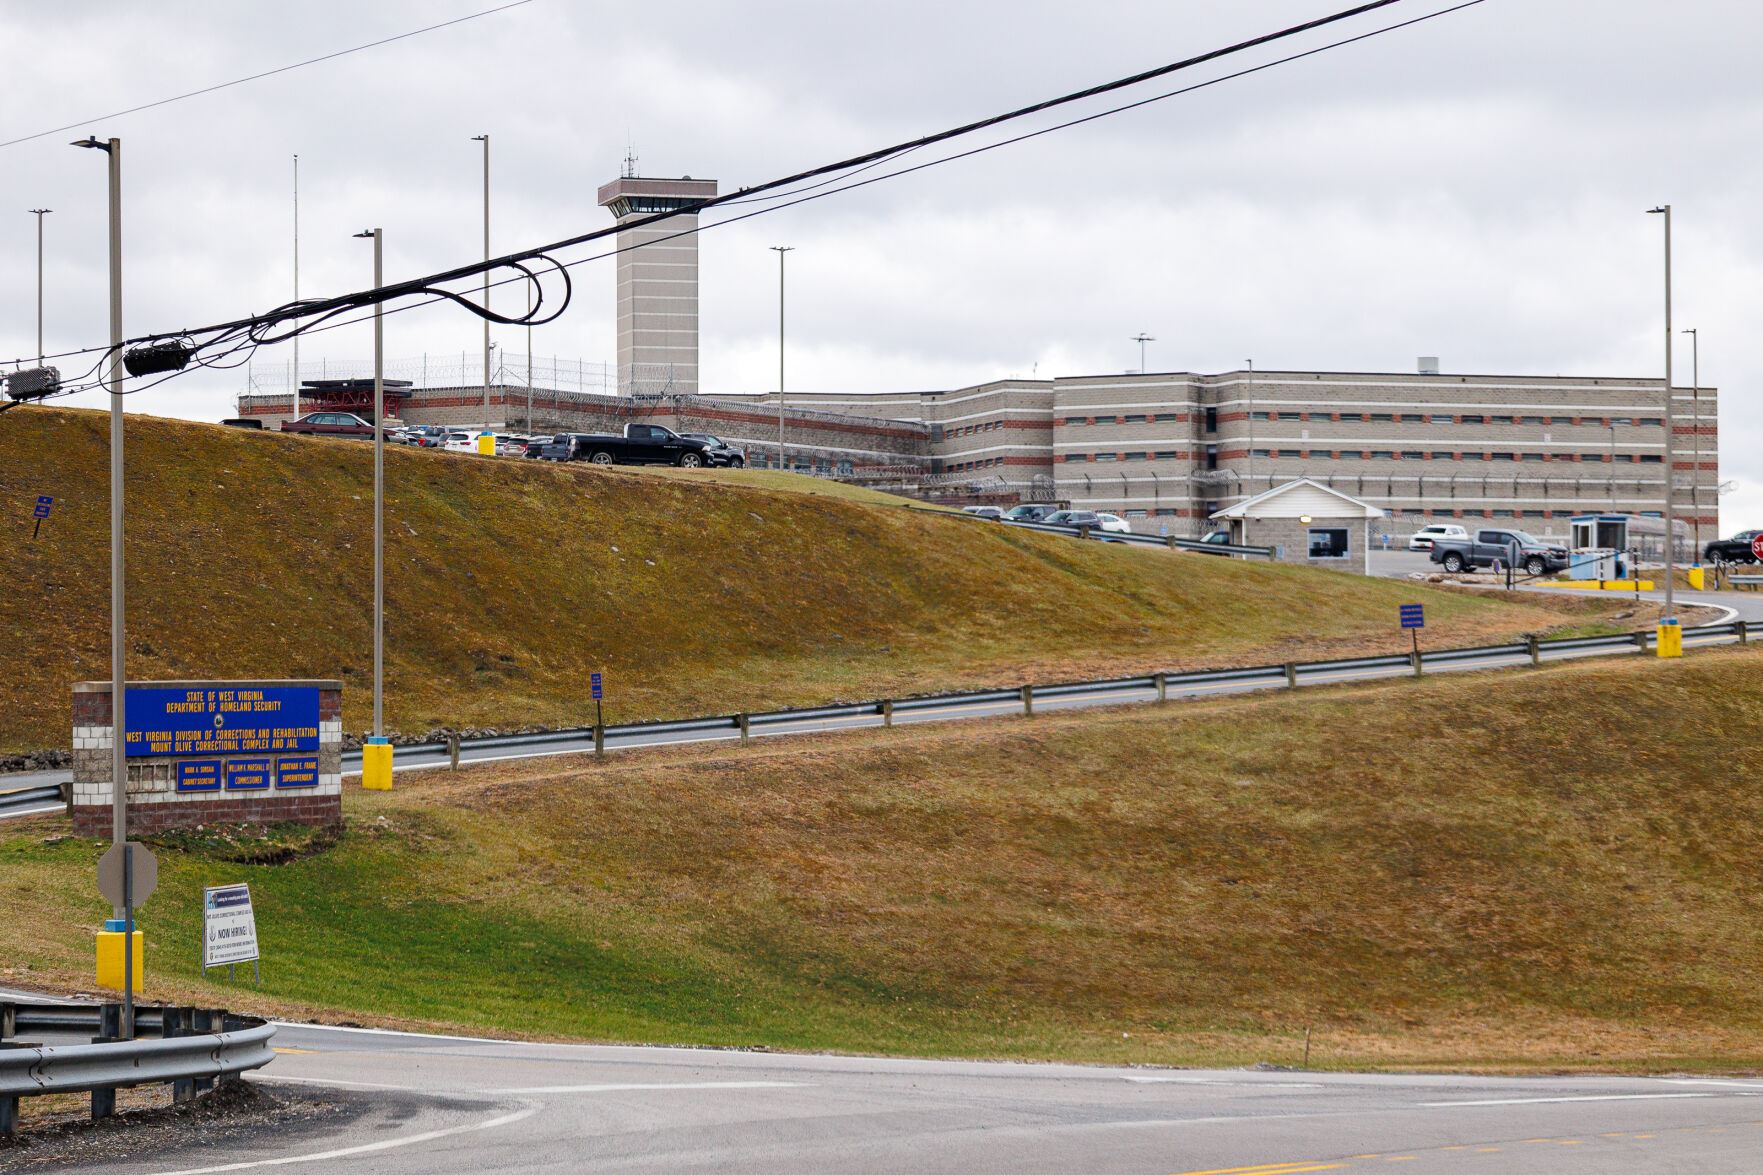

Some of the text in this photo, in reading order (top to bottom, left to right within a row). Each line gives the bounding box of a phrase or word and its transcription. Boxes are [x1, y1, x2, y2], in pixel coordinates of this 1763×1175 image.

[187, 691, 263, 702] STATE OF WEST VIRGINIA
[167, 701, 281, 712] DEPARTMENT OF HOMELAND SECURITY
[126, 728, 317, 742] WEST VIRGINIA DIVISION OF CORRECTIONS AND REHABILITATION
[151, 738, 298, 752] MOUNT OLIVE CORRECTIONAL COMPLEX AND JAIL
[229, 764, 243, 772] WILLIAM
[247, 763, 264, 771] MARSHALL
[235, 776, 262, 784] COMMISSIONER
[282, 774, 313, 782] SUPERINTENDENT
[218, 928, 230, 939] NOW
